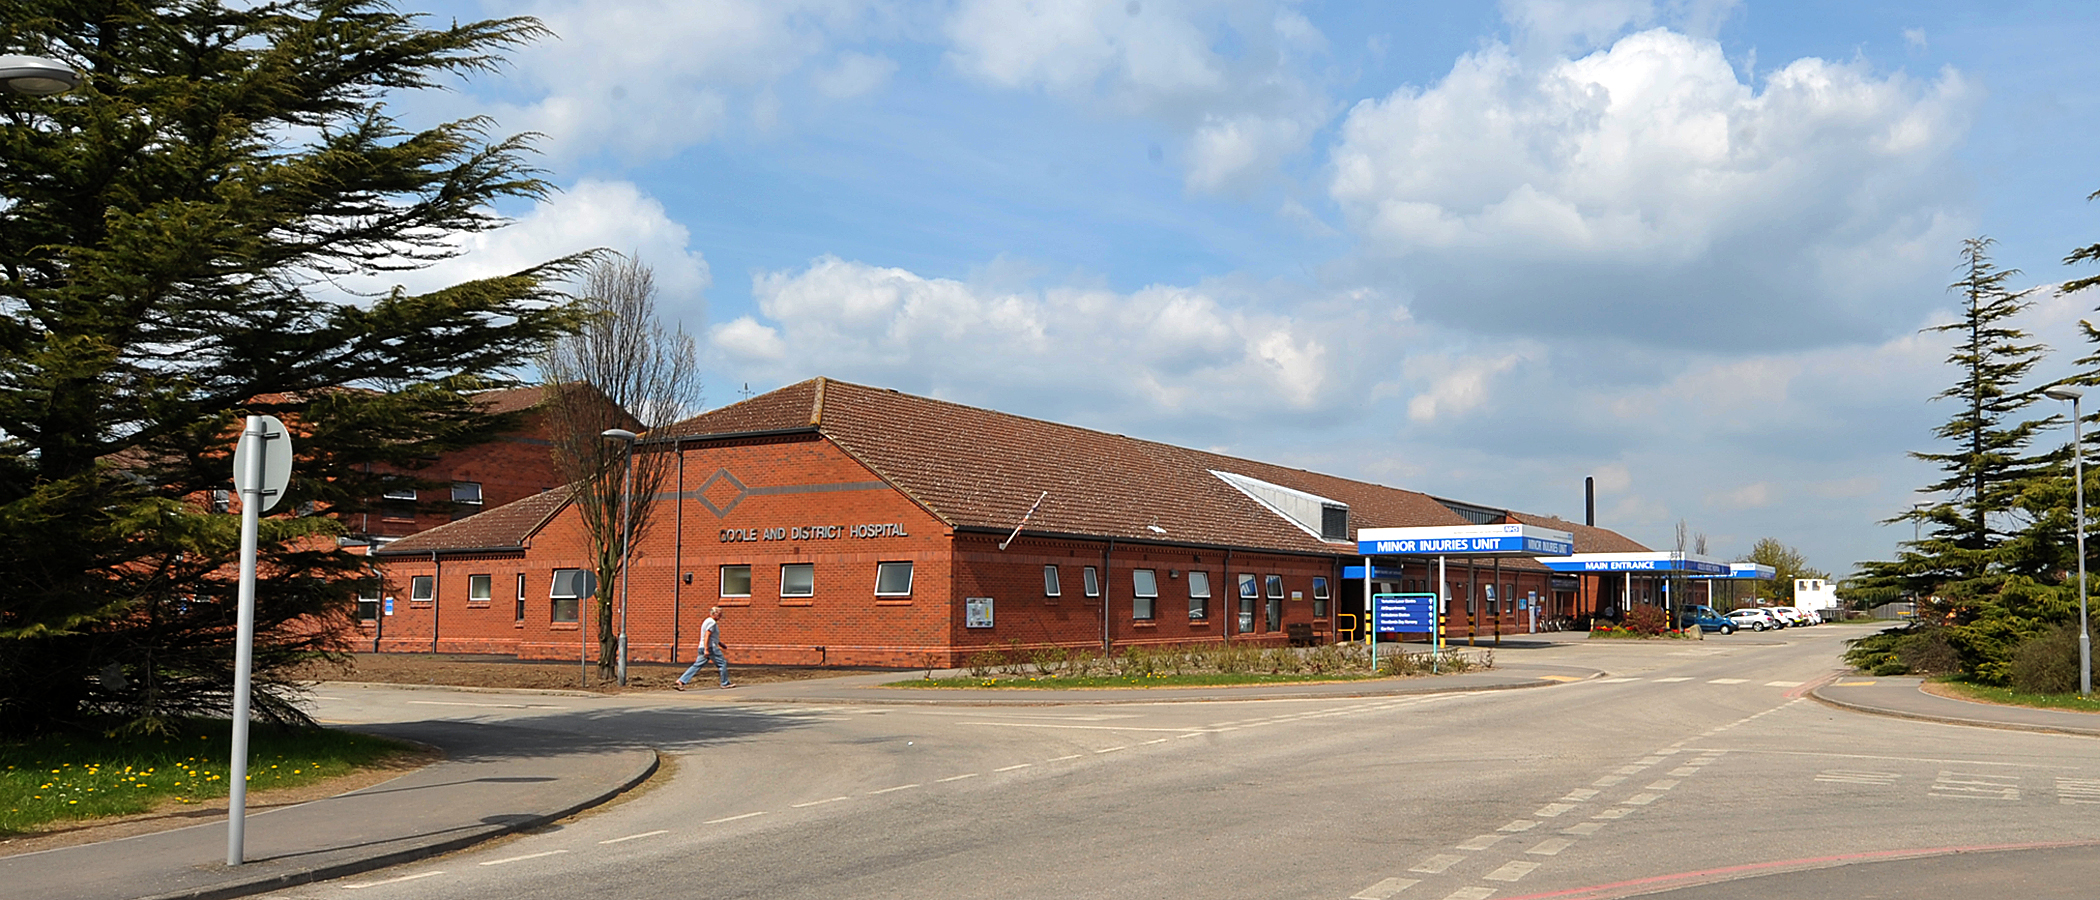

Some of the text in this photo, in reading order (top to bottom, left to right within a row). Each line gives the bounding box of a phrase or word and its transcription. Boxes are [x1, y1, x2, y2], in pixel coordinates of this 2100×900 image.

[719, 523, 908, 543] GOOLE AND DISTRICT HOSPITAL
[1377, 538, 1501, 552] MINOR INJURIES UNIT
[1585, 561, 1655, 570] MAIN ENTRANCE
